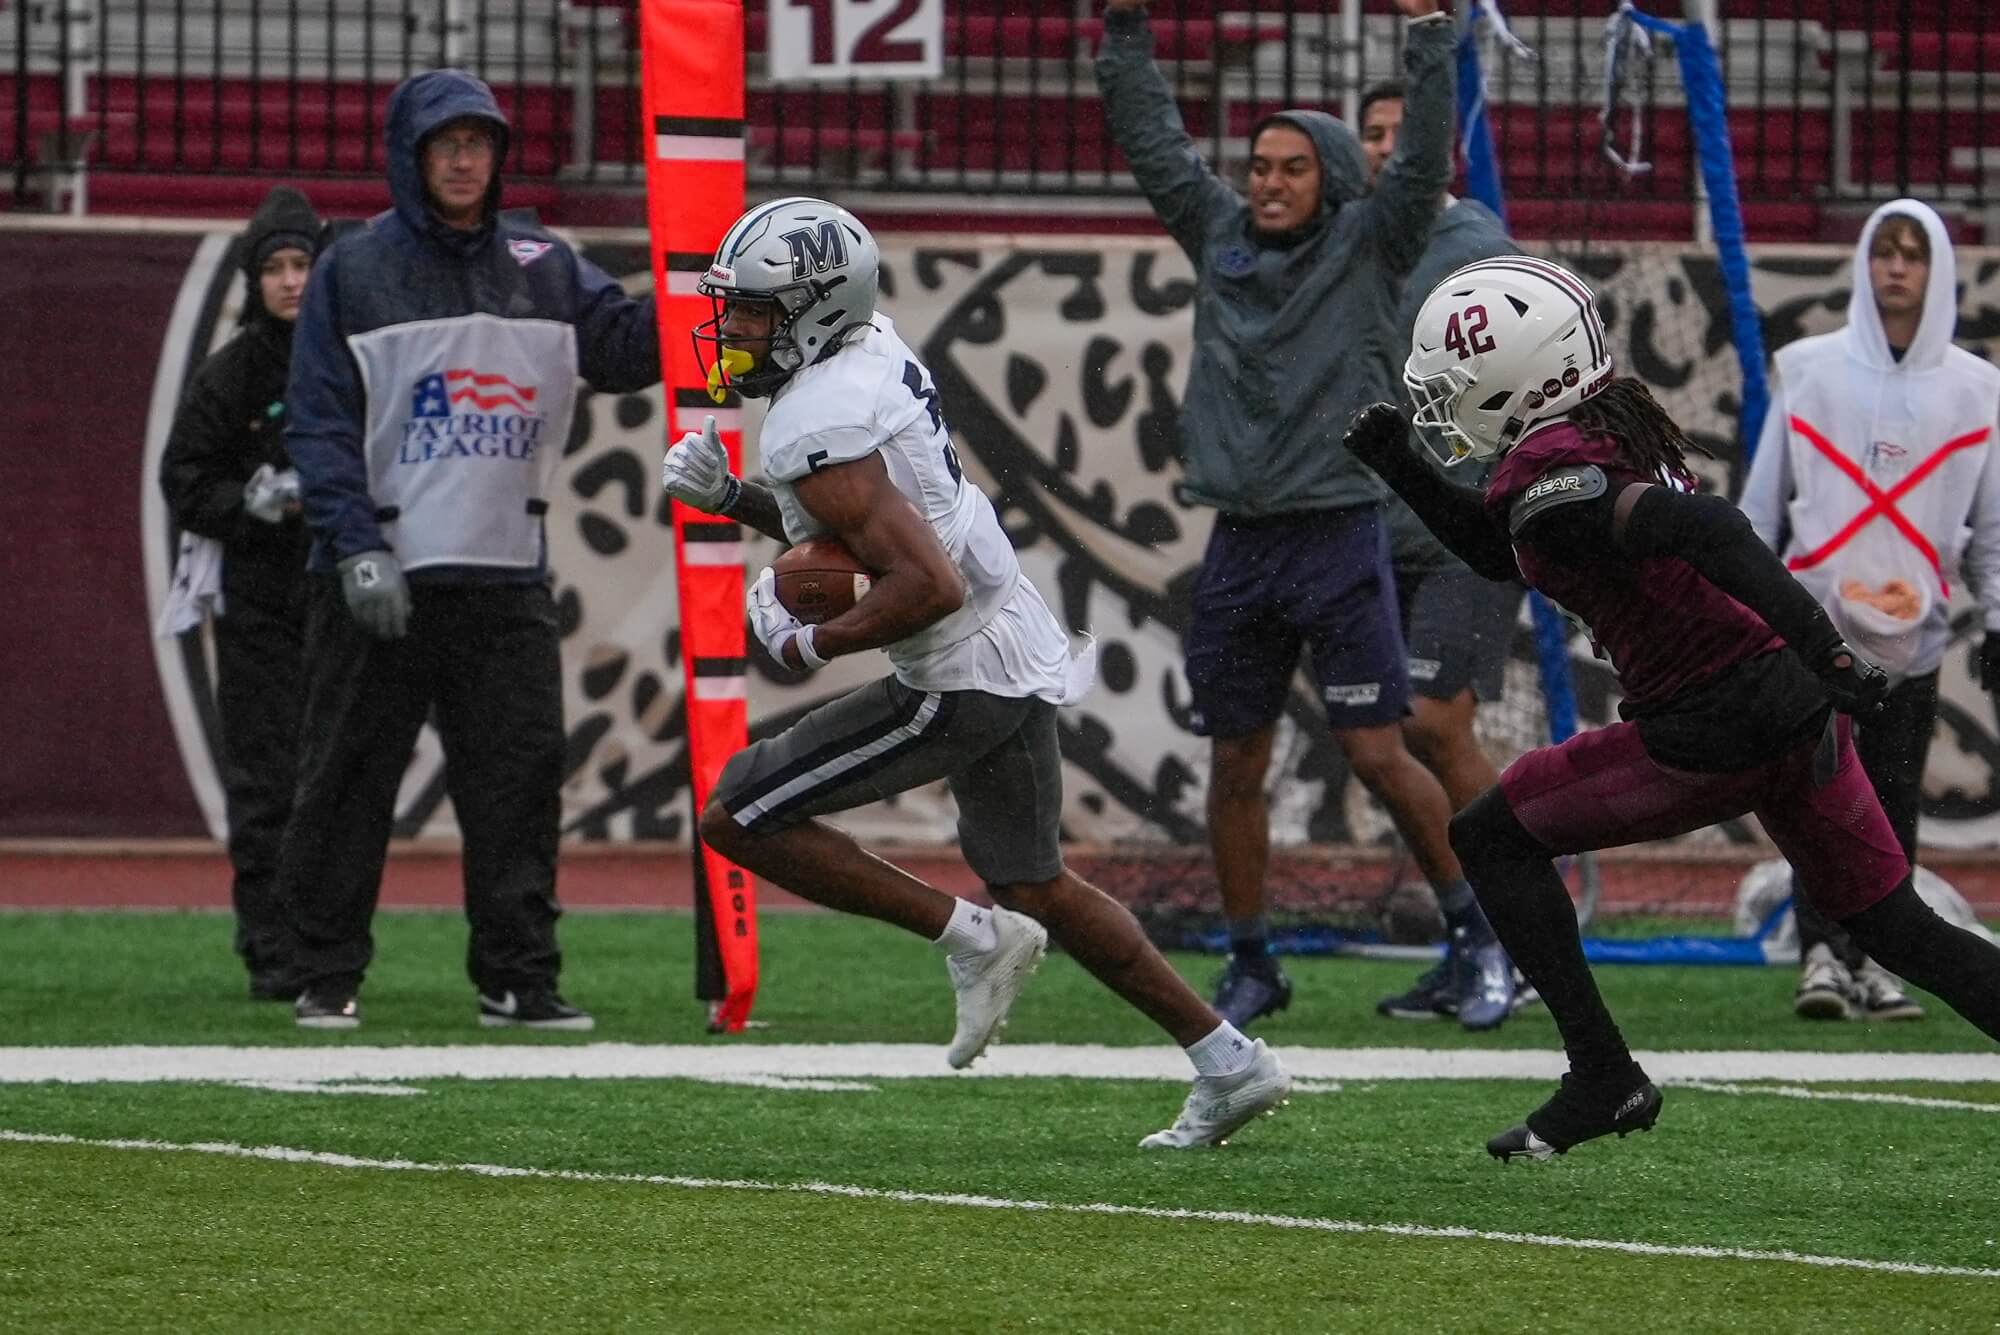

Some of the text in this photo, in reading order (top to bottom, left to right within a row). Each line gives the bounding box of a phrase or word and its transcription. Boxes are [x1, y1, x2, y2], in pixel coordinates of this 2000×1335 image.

[788, 0, 924, 64] 12
[779, 219, 849, 282] M
[1444, 304, 1497, 361] 42
[402, 413, 543, 442] PATRIOT
[399, 436, 538, 464] LEAGUE
[1525, 475, 1581, 503] GEAR
